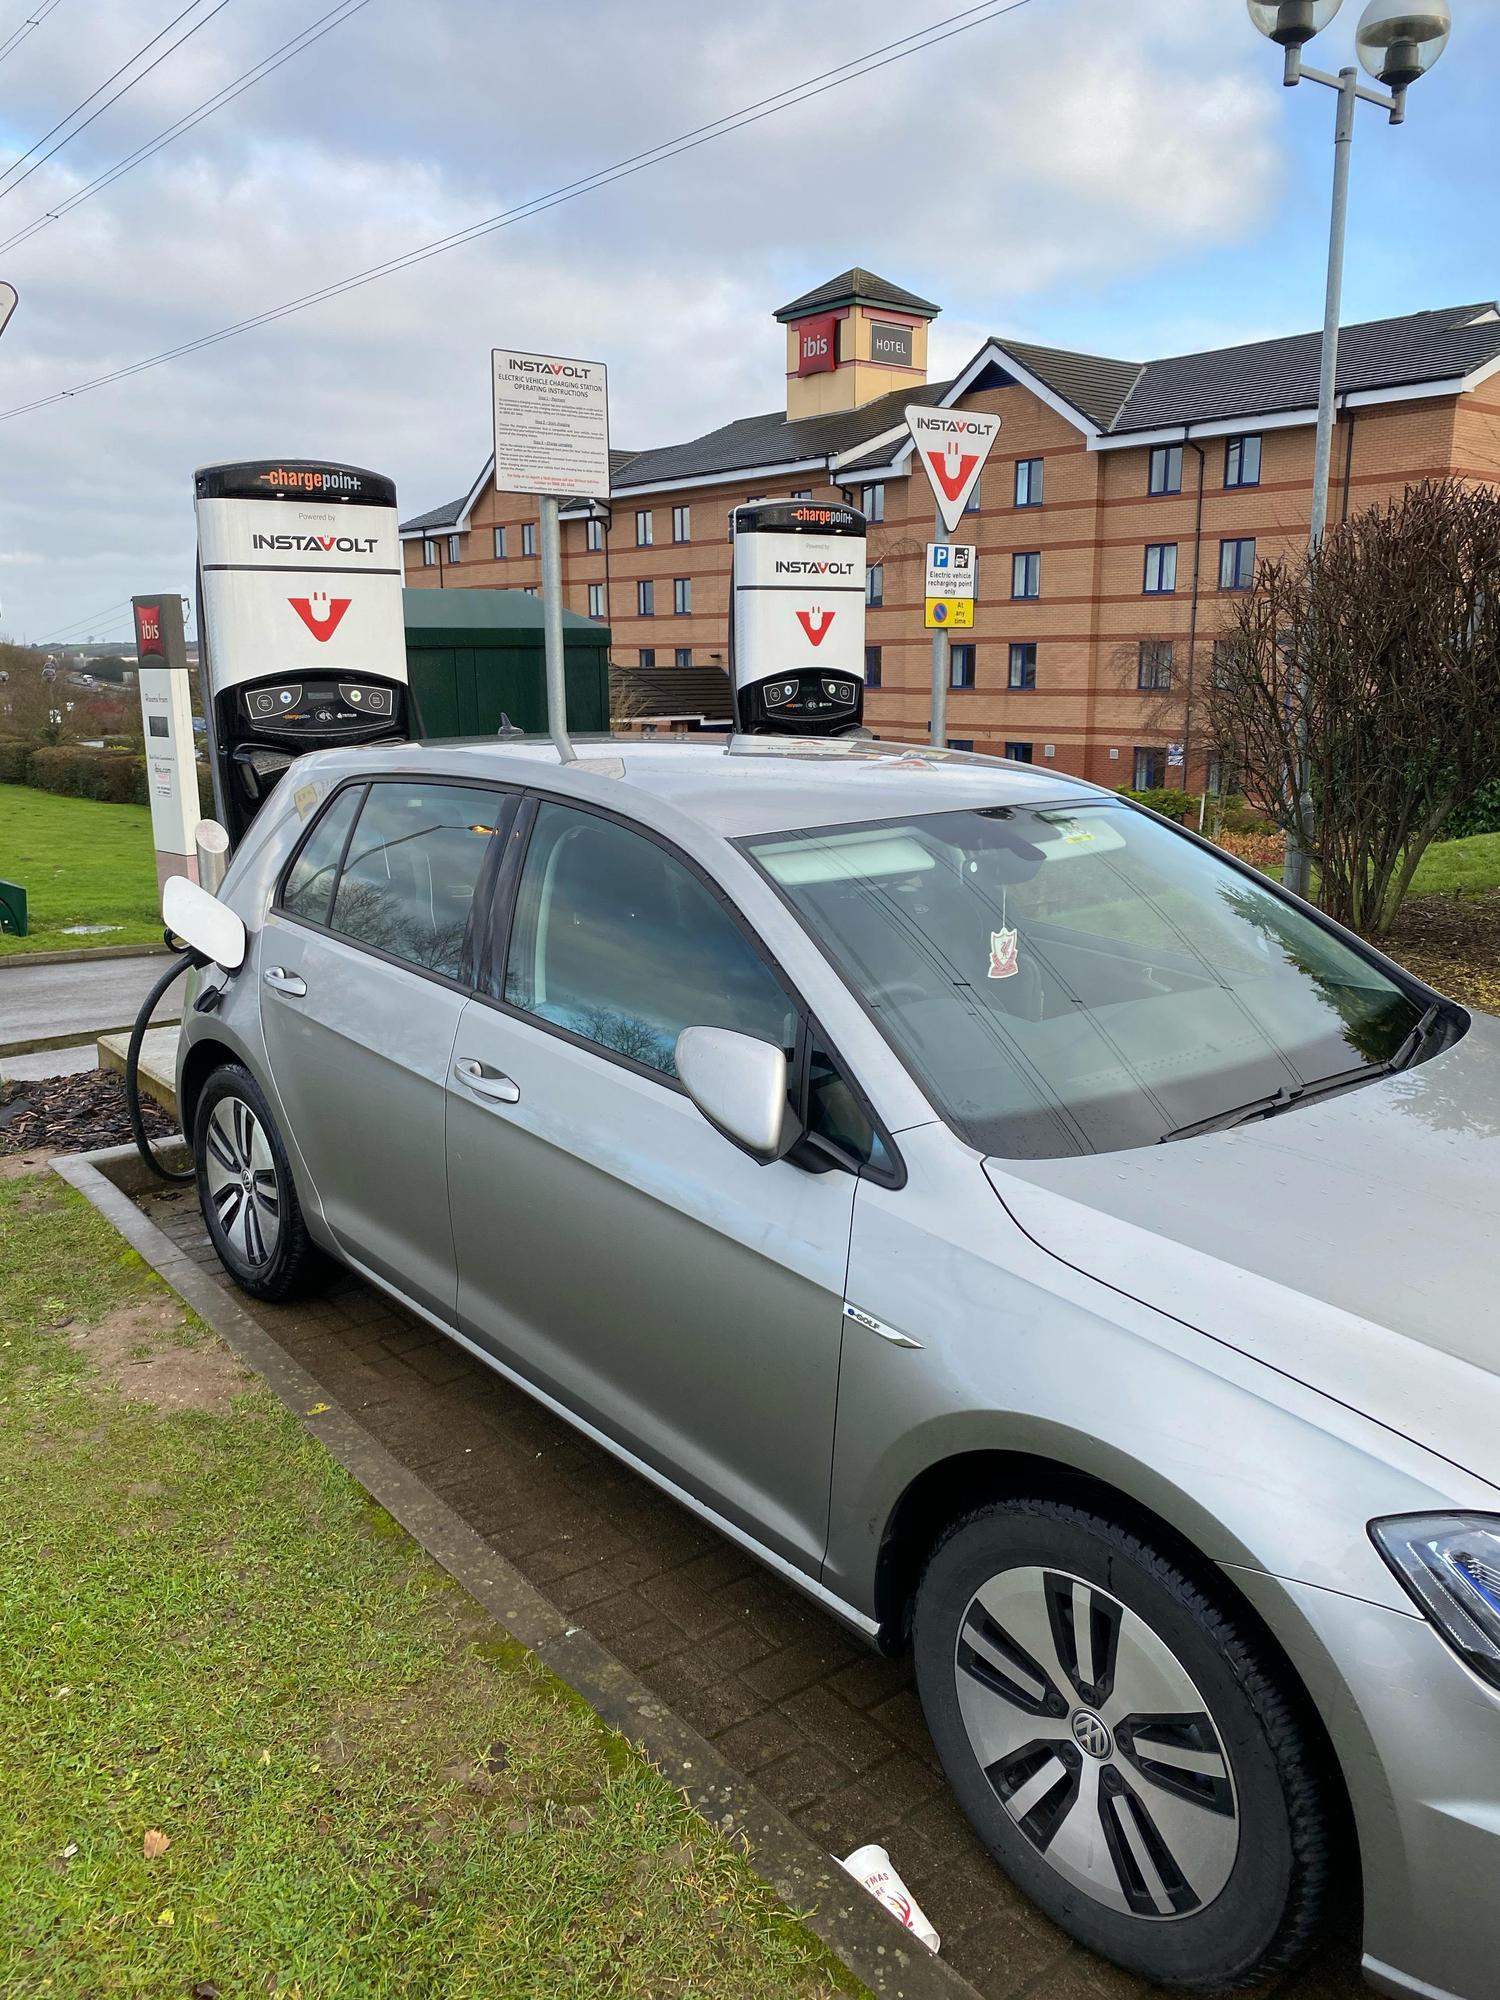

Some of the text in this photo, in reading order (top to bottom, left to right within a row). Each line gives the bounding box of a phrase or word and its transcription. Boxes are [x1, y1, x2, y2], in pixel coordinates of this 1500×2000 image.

[803, 334, 828, 358] ibis
[876, 339, 906, 354] HOTEL
[509, 359, 591, 379] INSTAVOLT
[498, 373, 603, 392] ELECTRIC VEHICLE CHARGING STATION
[514, 383, 588, 398] OPERATING INSTRUCTIONS
[917, 417, 993, 436] INSTAVOLT
[298, 512, 336, 522] Powered by
[252, 534, 379, 553] INSTAVOLT
[775, 560, 854, 575] INSTAVOLT
[929, 570, 971, 579] Electric vehicle
[928, 580, 972, 588] recharging point
[957, 601, 964, 609] At
[142, 620, 160, 640] ibis
